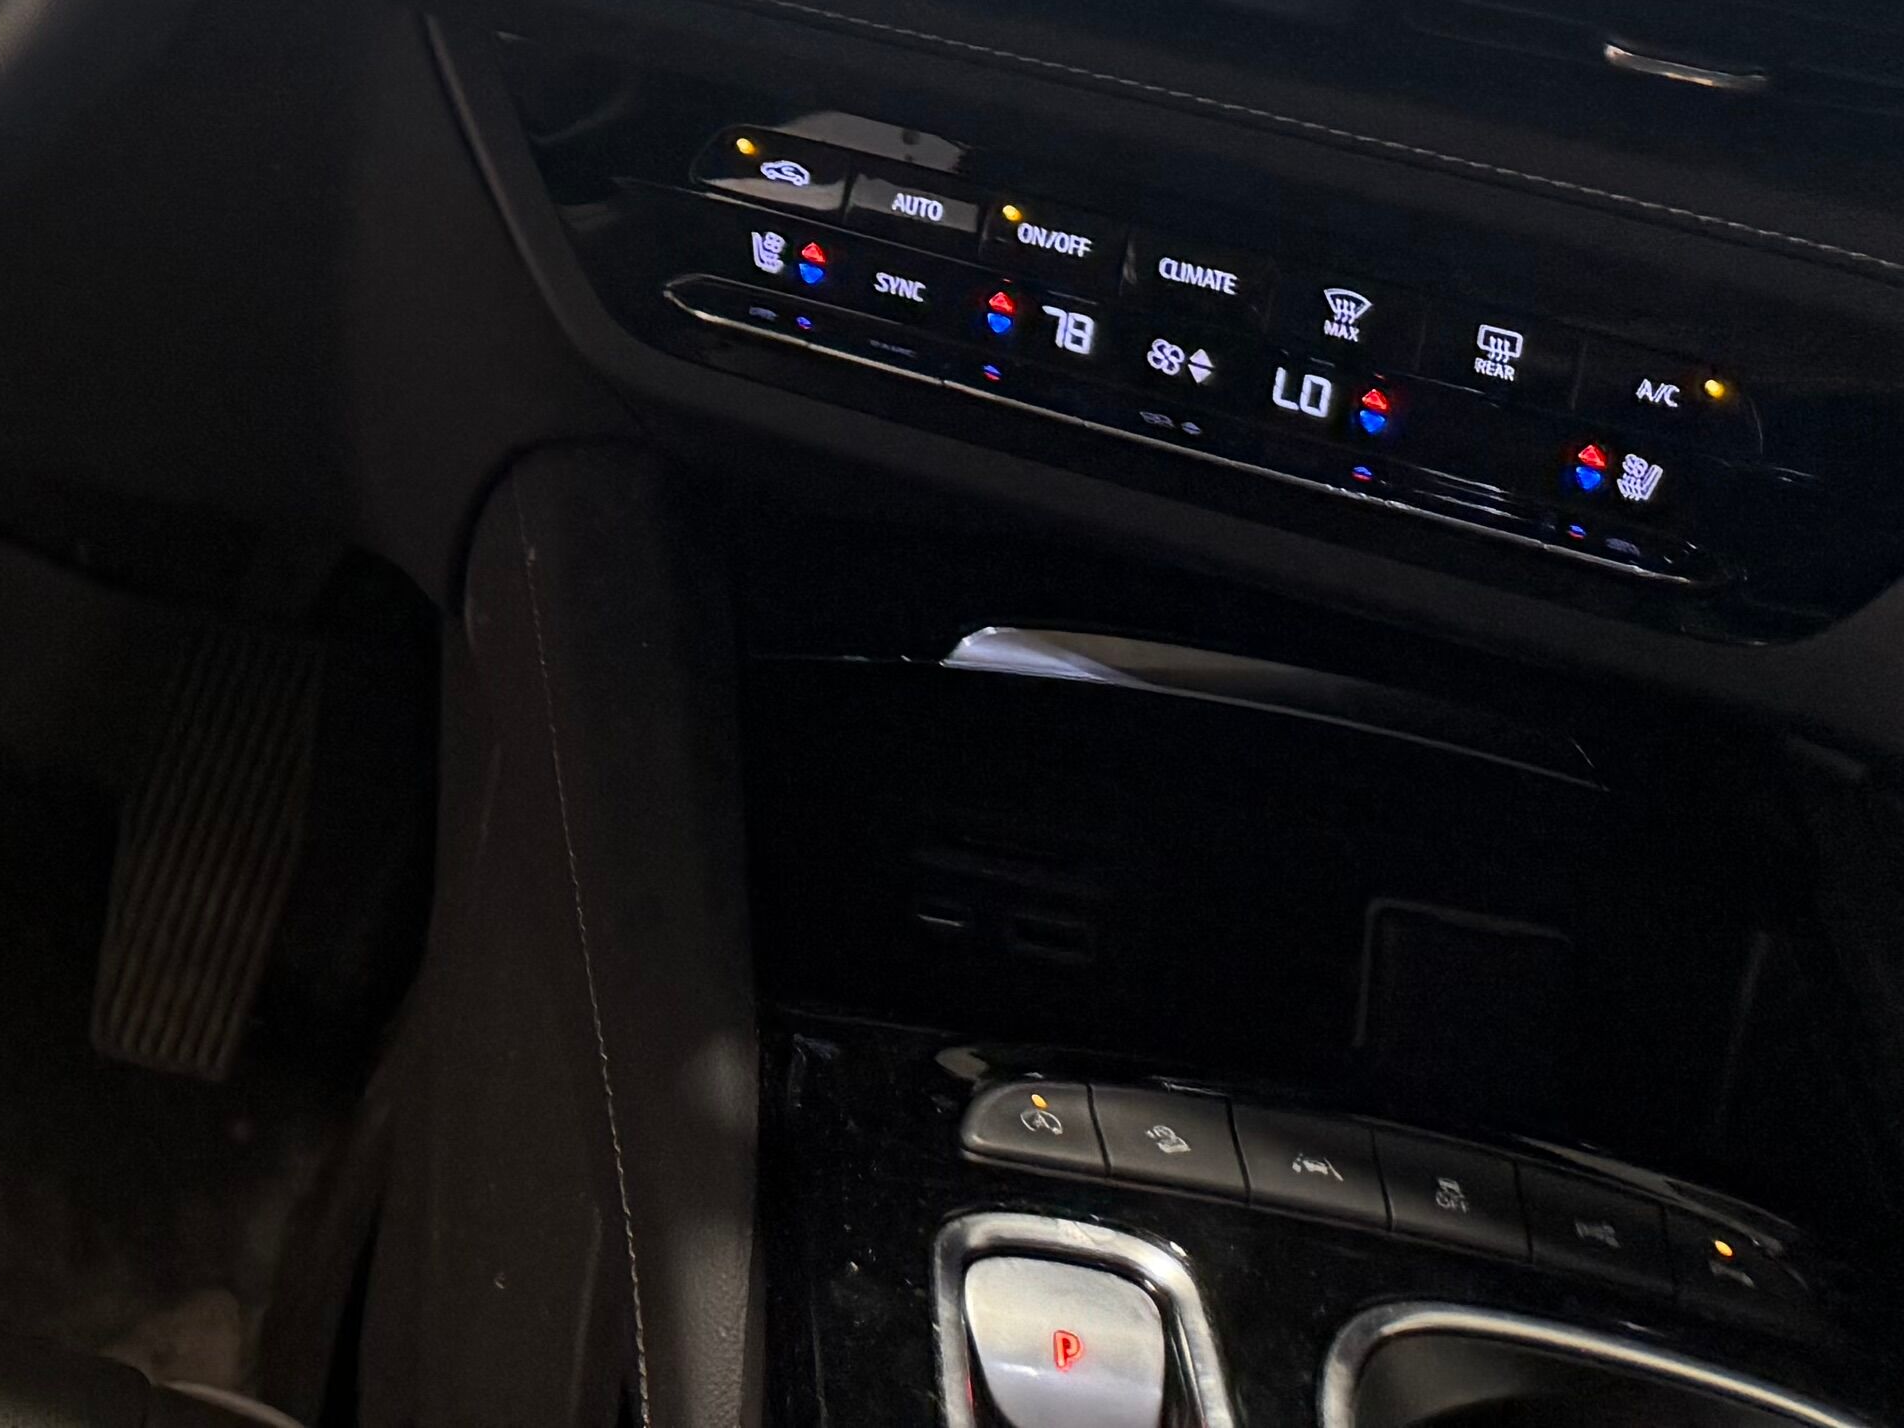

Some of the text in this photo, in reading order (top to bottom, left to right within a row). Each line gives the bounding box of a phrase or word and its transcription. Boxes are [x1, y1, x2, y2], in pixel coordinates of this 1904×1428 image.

[892, 192, 945, 223] AUTO
[1016, 221, 1093, 258] ON/OFF
[873, 271, 926, 303] SYNC
[1157, 256, 1238, 296] CLIMATE
[1042, 304, 1095, 356] 78
[1323, 319, 1360, 344] MAX
[1473, 355, 1516, 382] REAR
[1272, 366, 1333, 419] LO
[1635, 377, 1680, 408] A/C
[1053, 1328, 1081, 1369] P
